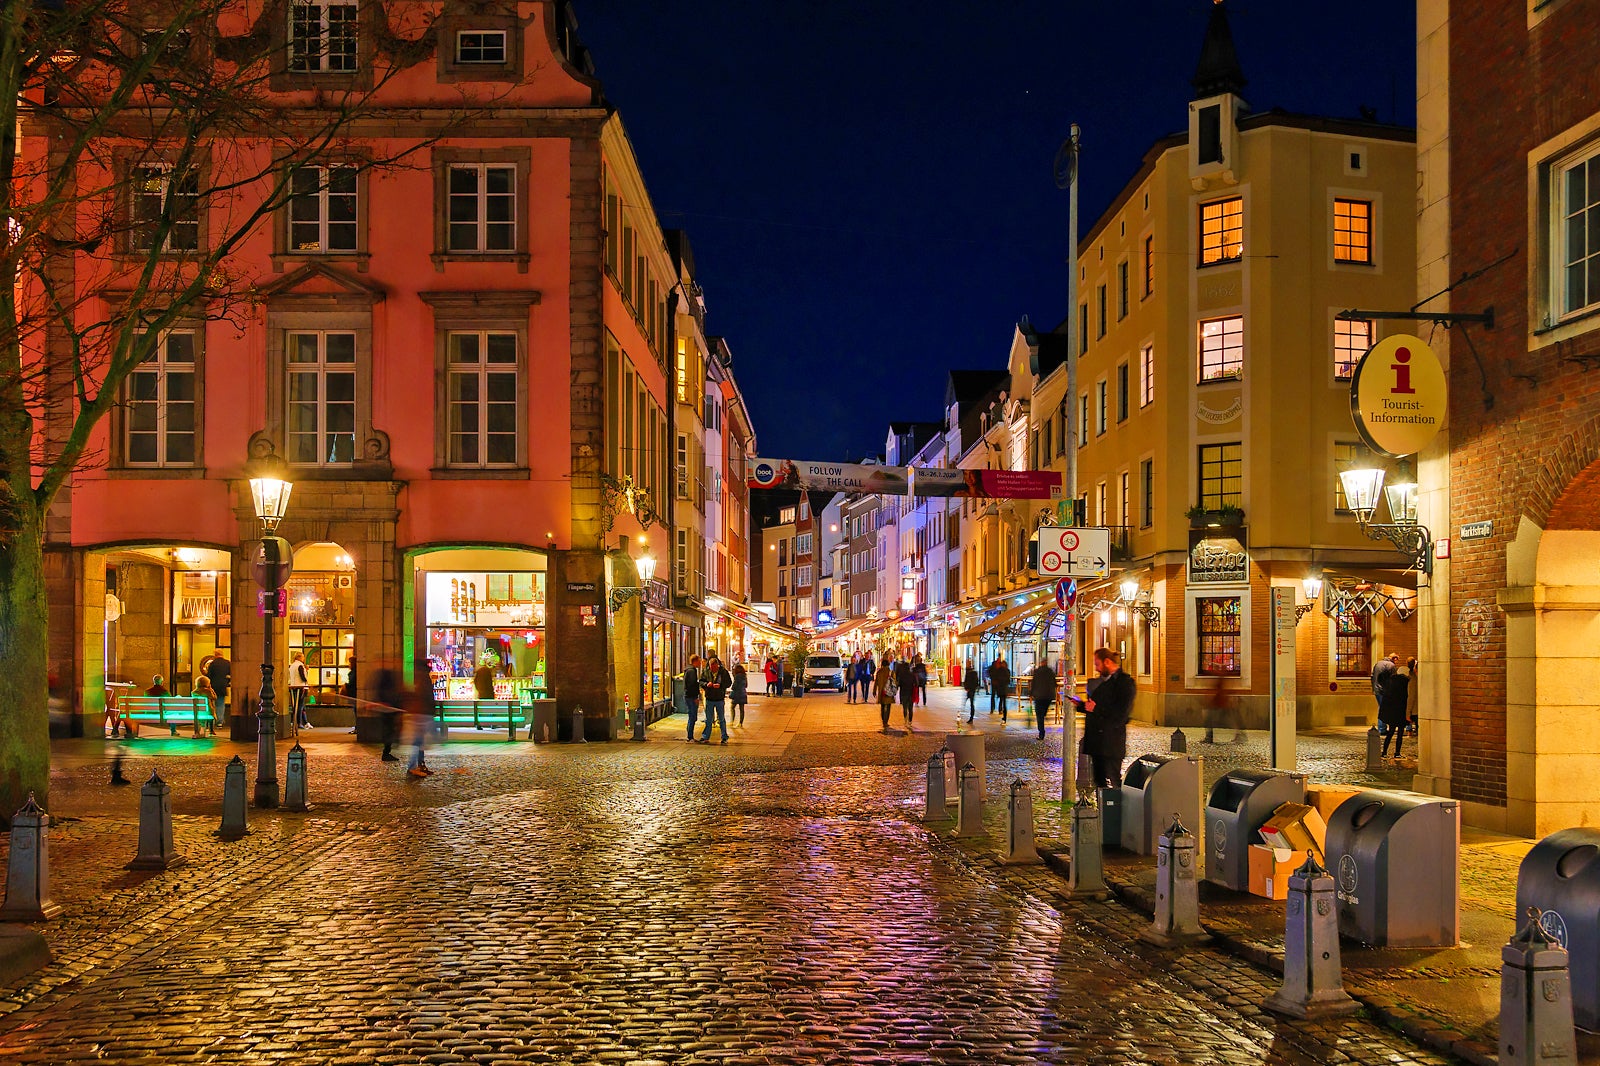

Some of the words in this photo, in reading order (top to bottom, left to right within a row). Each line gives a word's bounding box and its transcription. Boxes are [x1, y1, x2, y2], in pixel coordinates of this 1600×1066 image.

[1381, 398, 1424, 410] Tourist-
[1370, 412, 1435, 424] Information
[809, 466, 842, 476] FOLLOW
[827, 477, 842, 486] THE
[843, 478, 866, 488] CALL.
